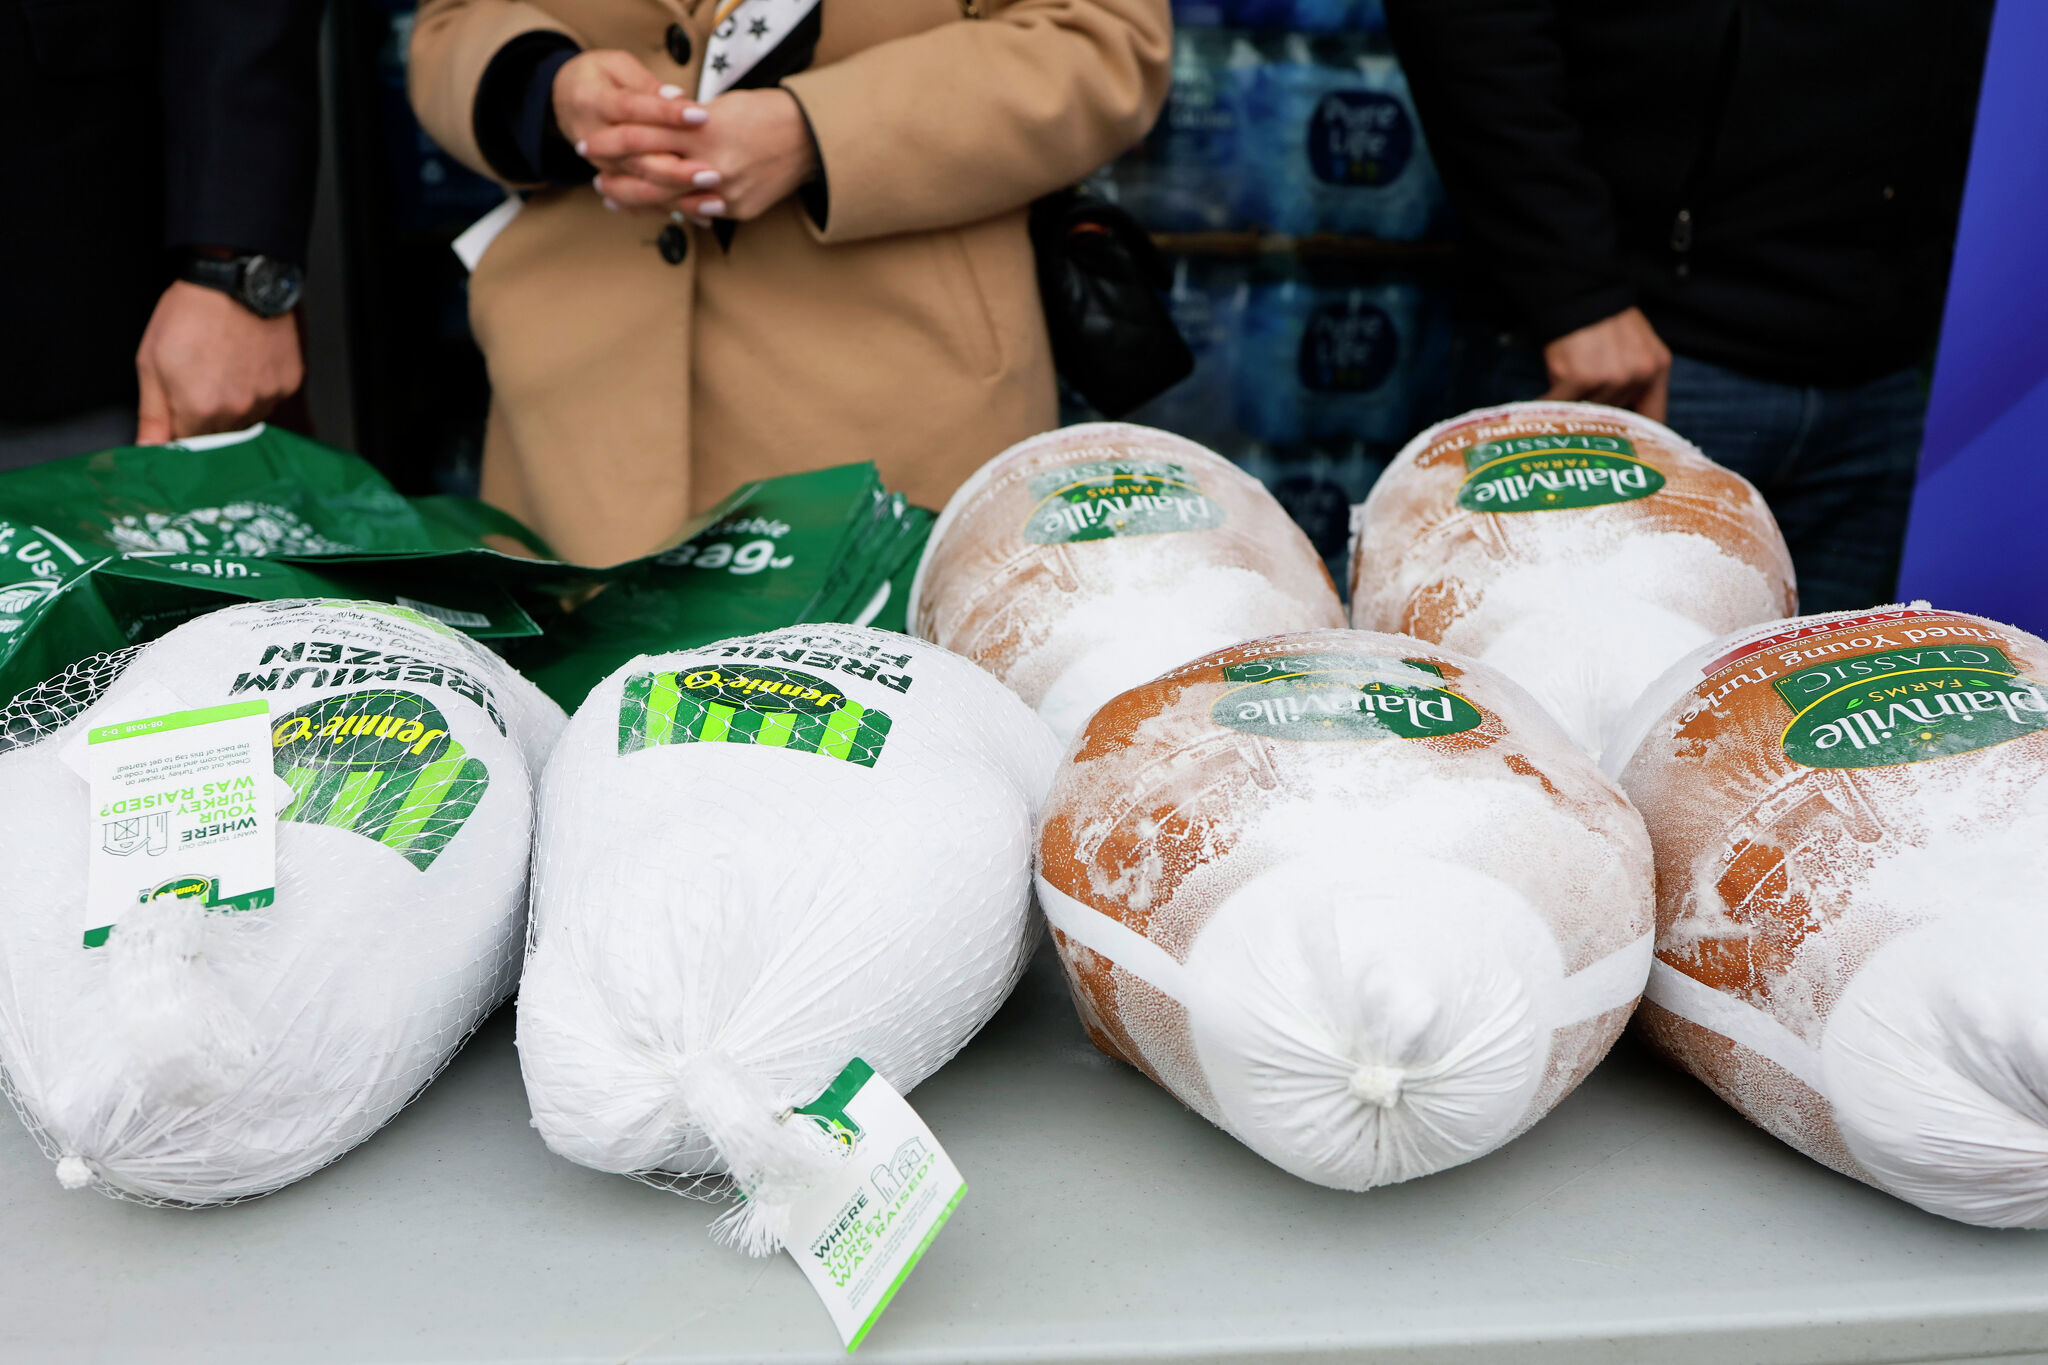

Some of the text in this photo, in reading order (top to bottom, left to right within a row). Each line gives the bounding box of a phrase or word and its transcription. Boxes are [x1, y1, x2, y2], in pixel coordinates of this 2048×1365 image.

[1478, 436, 1619, 461] CLASSIC
[1520, 458, 1588, 473] FARMS
[1086, 484, 1154, 499] FARMS
[1836, 621, 1906, 637] SOLUTION
[1815, 633, 1833, 642] OF
[1765, 639, 1811, 655] WATER
[1779, 633, 1896, 667] Young
[1735, 654, 1762, 669] AND
[1709, 667, 1733, 682] SEA
[1797, 649, 1990, 693] CLASSIC
[1868, 678, 1963, 703] FARMS
[228, 666, 507, 738] PREMIUM
[100, 720, 163, 738] 08-1038 D-2
[204, 749, 214, 757] of
[215, 745, 235, 755] back
[236, 743, 249, 751] the
[148, 758, 161, 767] get
[174, 753, 188, 762] tag
[189, 751, 203, 760] this
[223, 758, 250, 768] Check
[115, 761, 147, 774] started!
[160, 763, 180, 772] enter
[182, 759, 197, 769] and
[210, 762, 223, 770] out
[123, 769, 143, 780] code
[137, 772, 165, 784] Tracker
[145, 768, 158, 776] the
[166, 766, 192, 778] Turkey
[100, 776, 255, 817] WAS RAISED?
[176, 790, 256, 816] TURKEY
[200, 803, 256, 824] YOUR
[181, 817, 257, 842] WHERE
[178, 829, 257, 852] WANT TO FIND OUT
[814, 1194, 868, 1258] WHERE
[836, 1241, 872, 1286] WAS
[875, 1153, 935, 1237] RAISED?
[822, 1219, 863, 1267] YOUR
[828, 1209, 882, 1278] TURKEY
